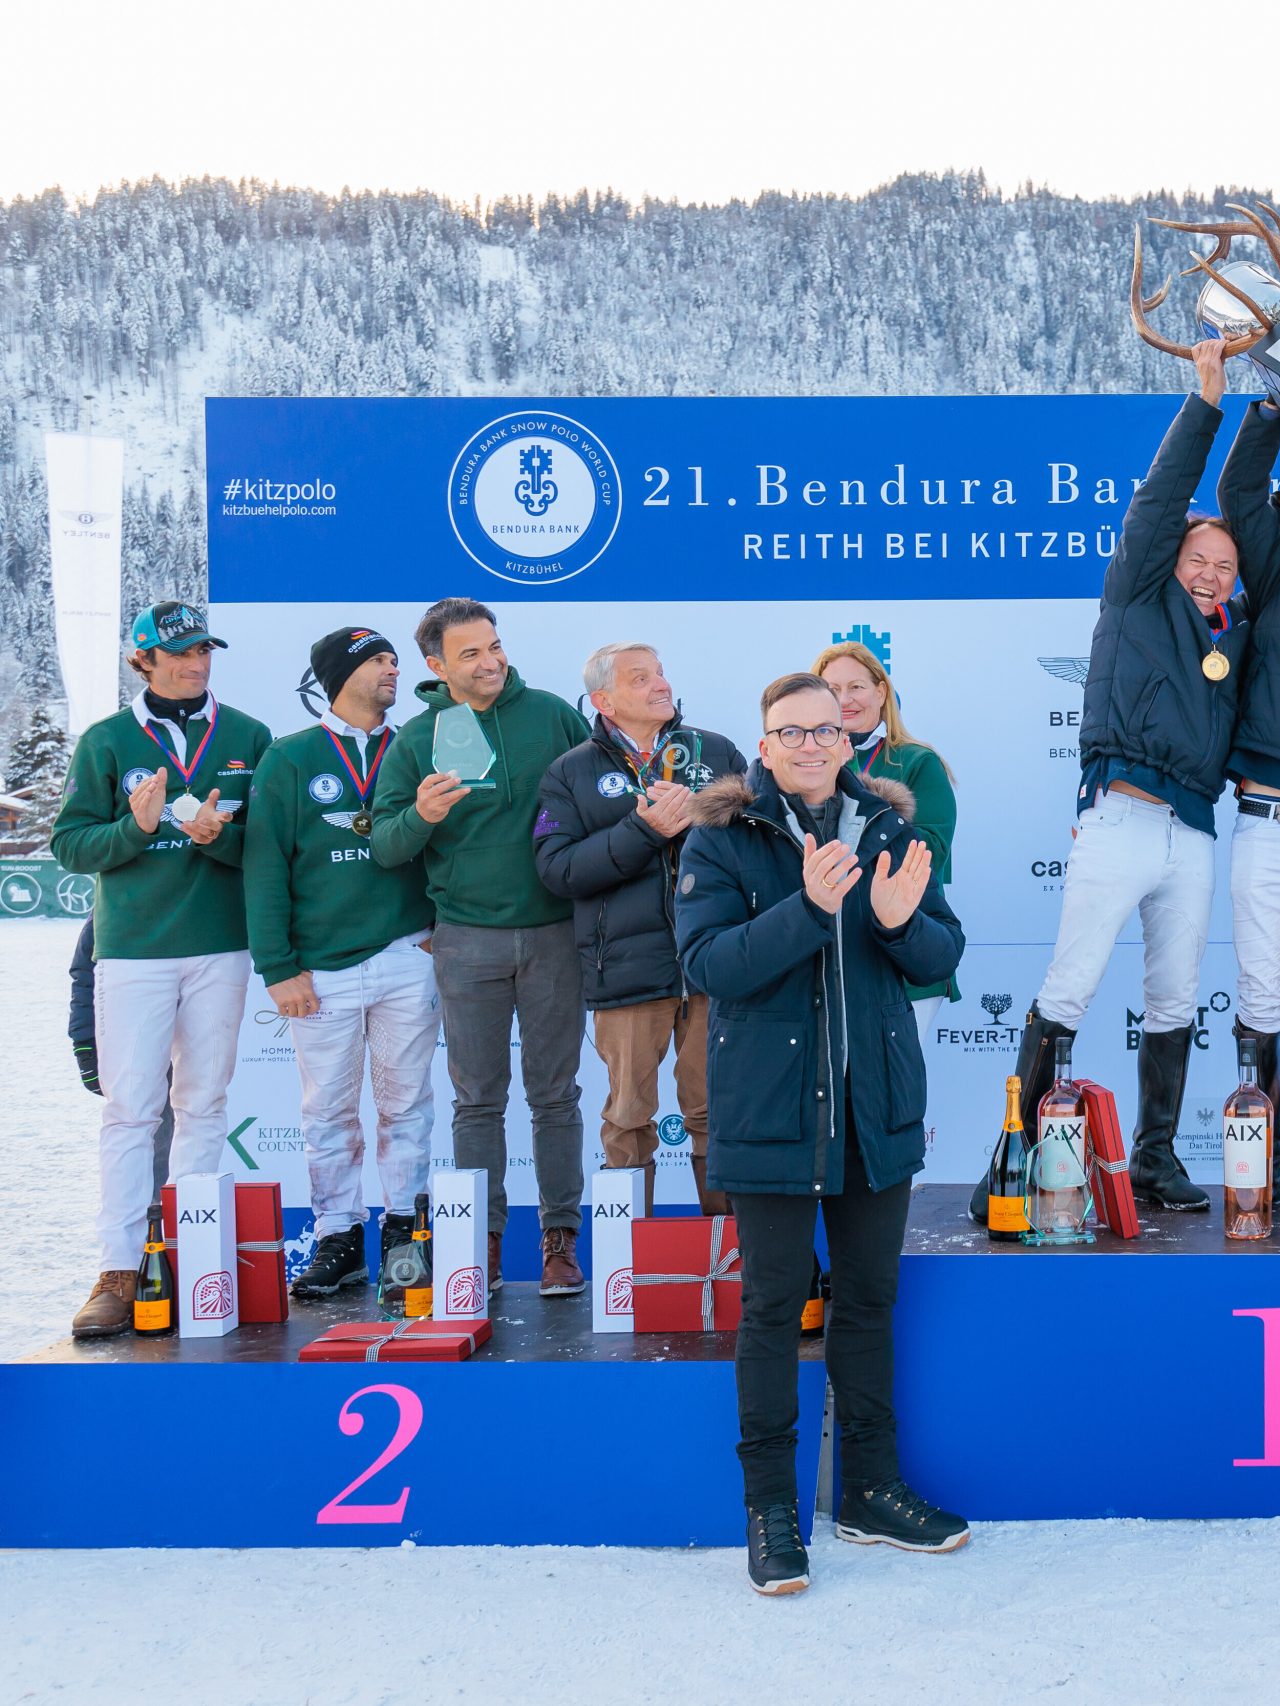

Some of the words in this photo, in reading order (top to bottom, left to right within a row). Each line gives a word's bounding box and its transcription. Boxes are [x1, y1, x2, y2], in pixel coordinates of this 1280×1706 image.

[459, 453, 481, 505] BENDURA
[479, 429, 508, 452] BANK
[511, 422, 547, 434] SNOW
[551, 424, 579, 443] POLO
[581, 441, 607, 478] WORLD
[601, 483, 611, 506] CUP
[1048, 463, 1152, 505] Ba
[223, 478, 336, 506] #kitzpolo
[222, 504, 336, 517] kitzbuehelpolo.com
[492, 525, 546, 534] BENDURA
[549, 525, 580, 534] BANK
[744, 533, 864, 560] REITH
[886, 533, 948, 559] BEI
[971, 525, 1116, 559] KITZBÜ
[505, 560, 564, 575] KITZBÜHEL
[217, 767, 255, 776] casablanc
[147, 839, 192, 850] BENT
[1043, 1122, 1083, 1141] AIX
[1226, 1124, 1263, 1141] AIX
[257, 1141, 307, 1152] COUNT
[1189, 1142, 1203, 1150] Das
[1204, 1142, 1223, 1150] Tirol
[179, 1209, 217, 1224] AIX
[435, 1203, 472, 1218] AIX
[594, 1203, 631, 1218] AIX
[315, 1384, 424, 1527] 2
